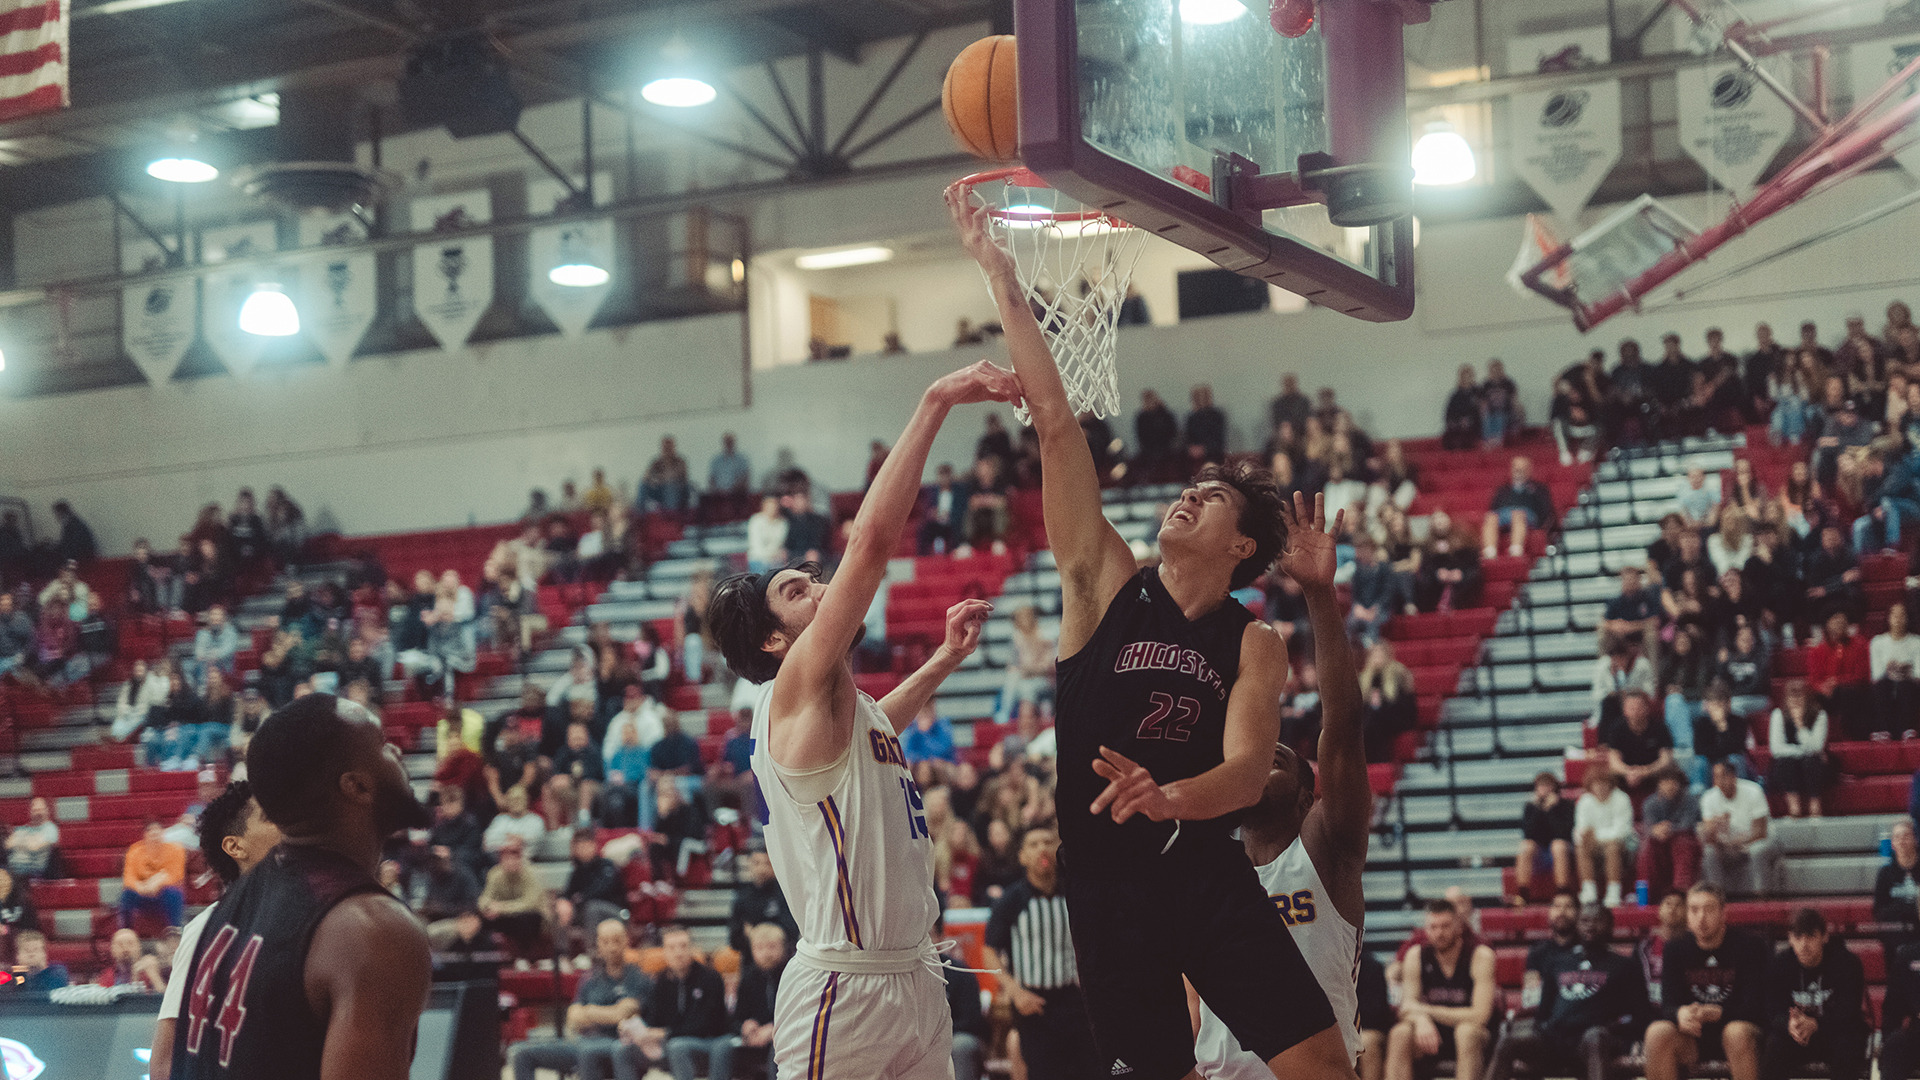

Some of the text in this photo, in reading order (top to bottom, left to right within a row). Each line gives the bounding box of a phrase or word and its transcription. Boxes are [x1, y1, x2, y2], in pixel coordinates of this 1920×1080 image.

[1114, 640, 1181, 673] CHICO
[1136, 691, 1201, 742] 22
[186, 923, 264, 1069] 44
